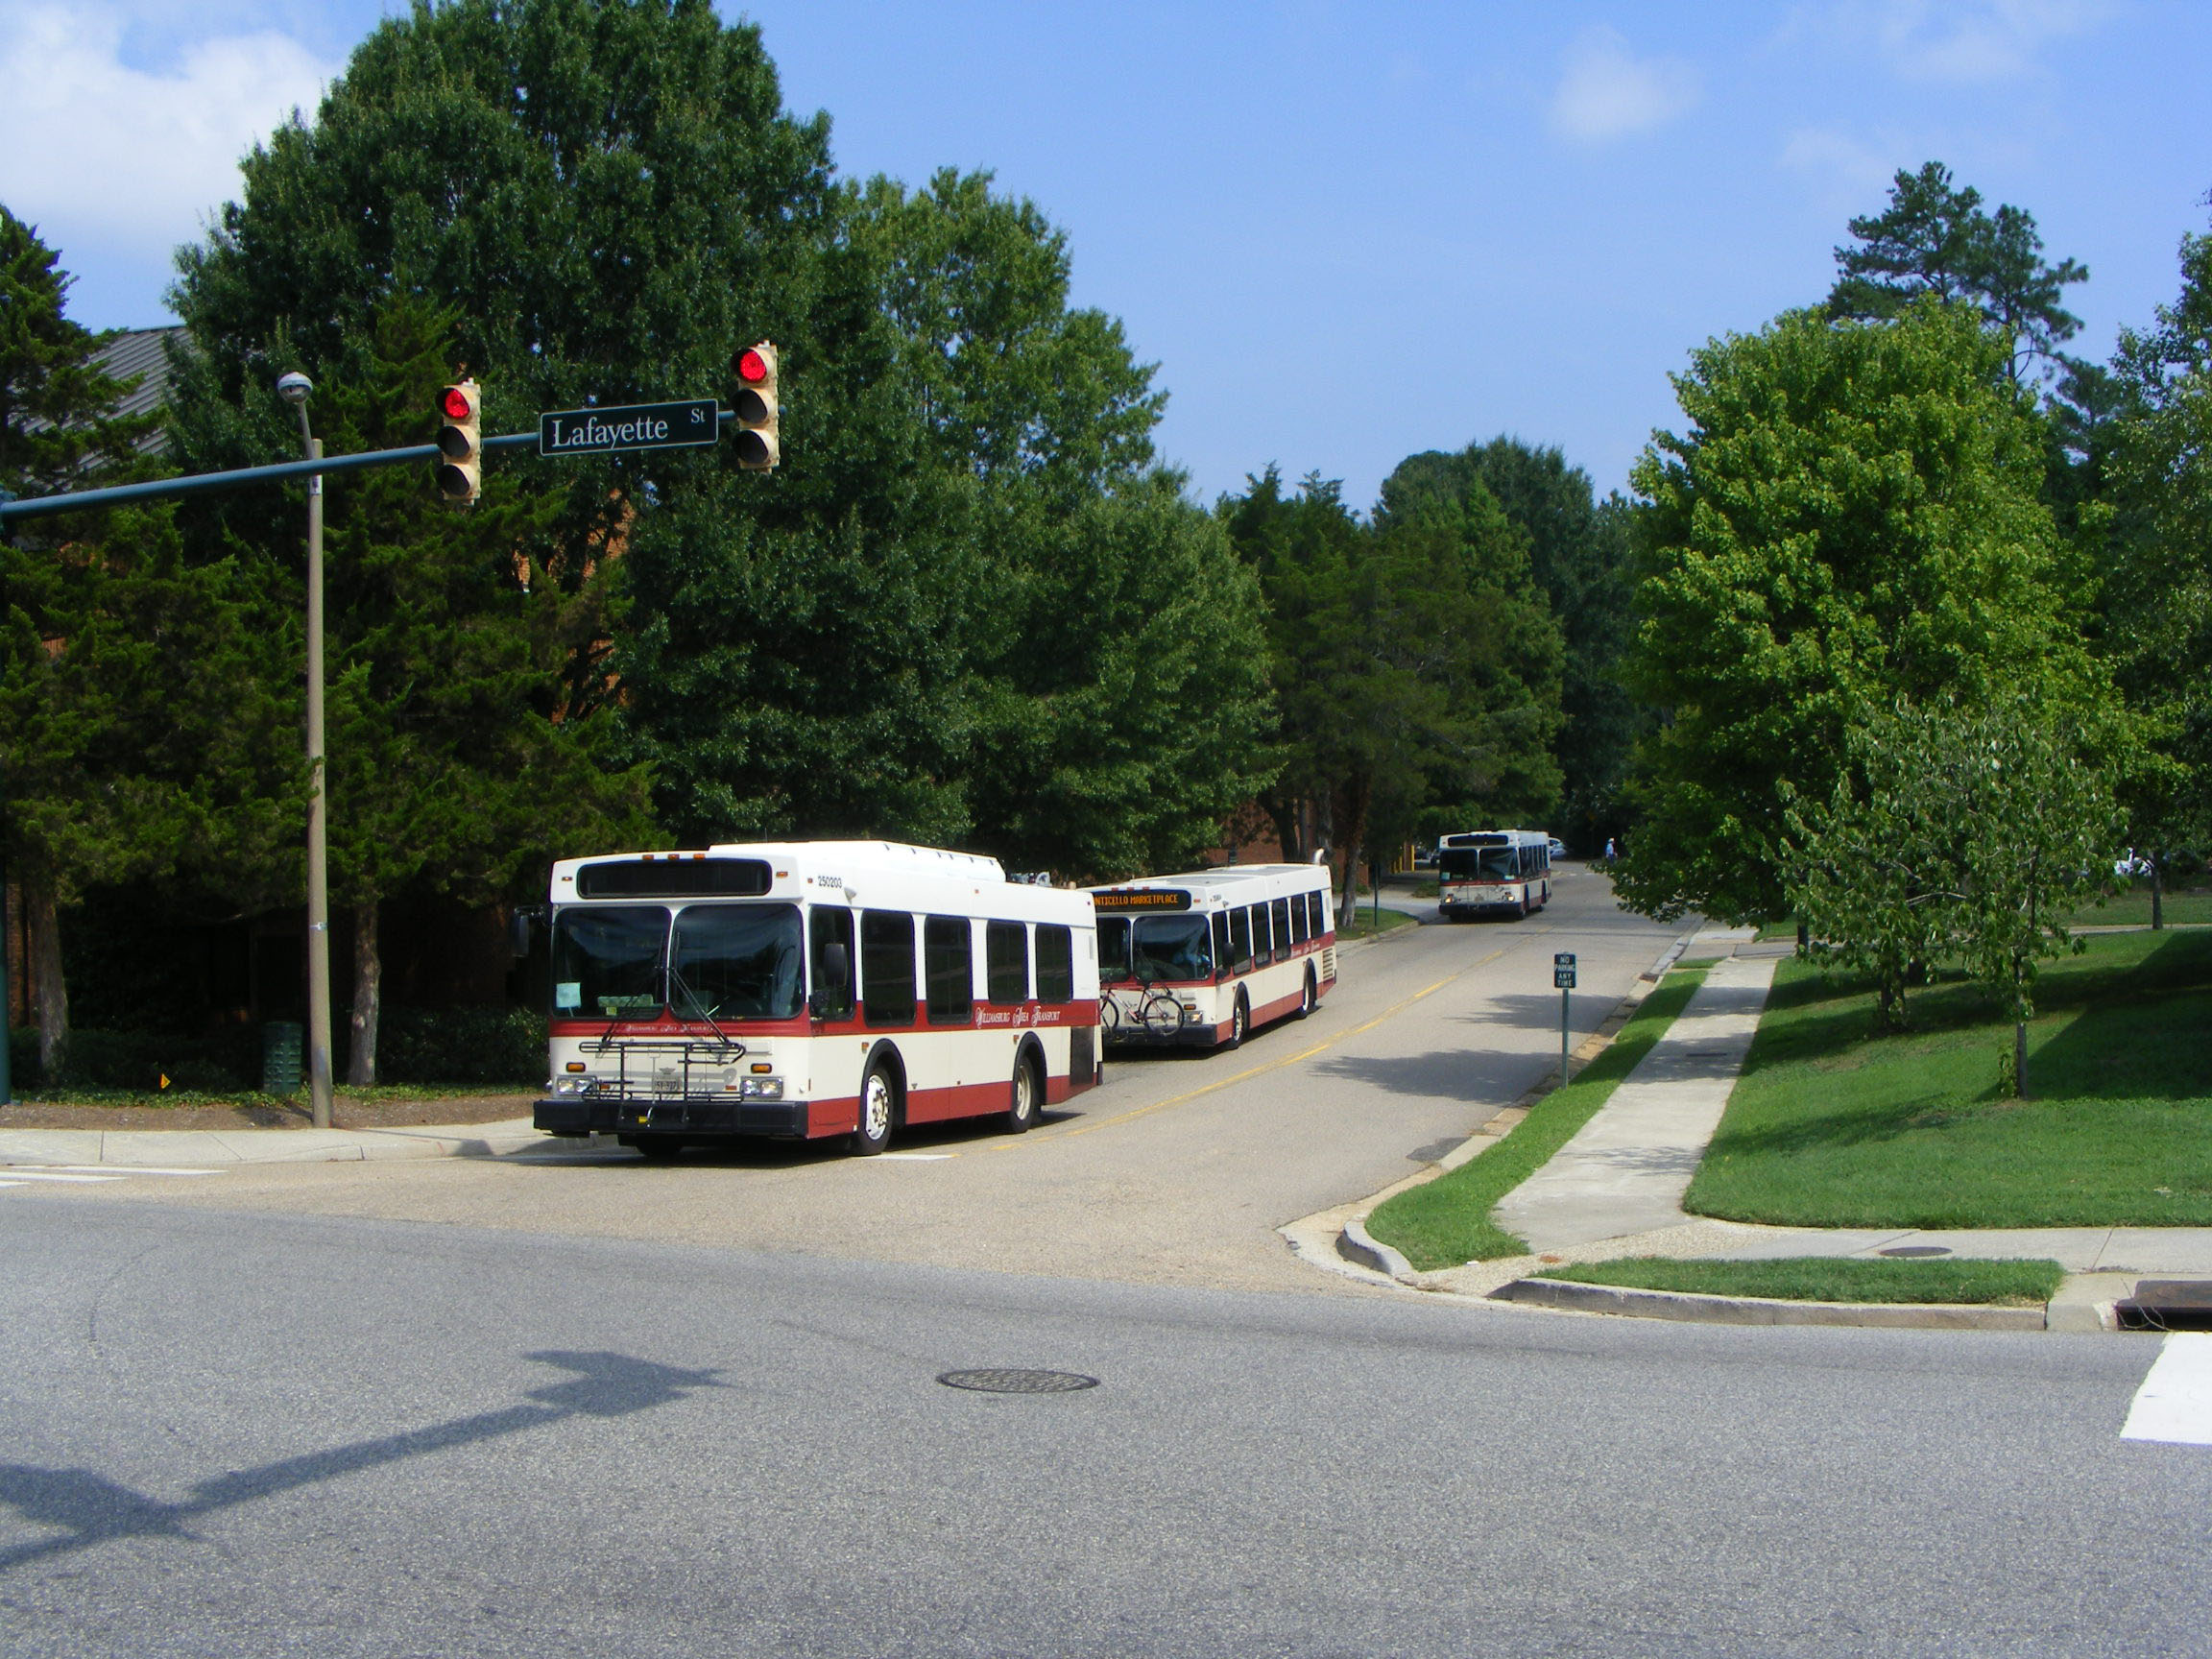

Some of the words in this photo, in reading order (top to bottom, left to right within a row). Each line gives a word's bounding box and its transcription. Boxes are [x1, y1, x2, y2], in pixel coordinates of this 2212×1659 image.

[552, 417, 668, 449] Lafayette
[690, 408, 705, 423] St
[1130, 894, 1178, 904] MARKETPLACE
